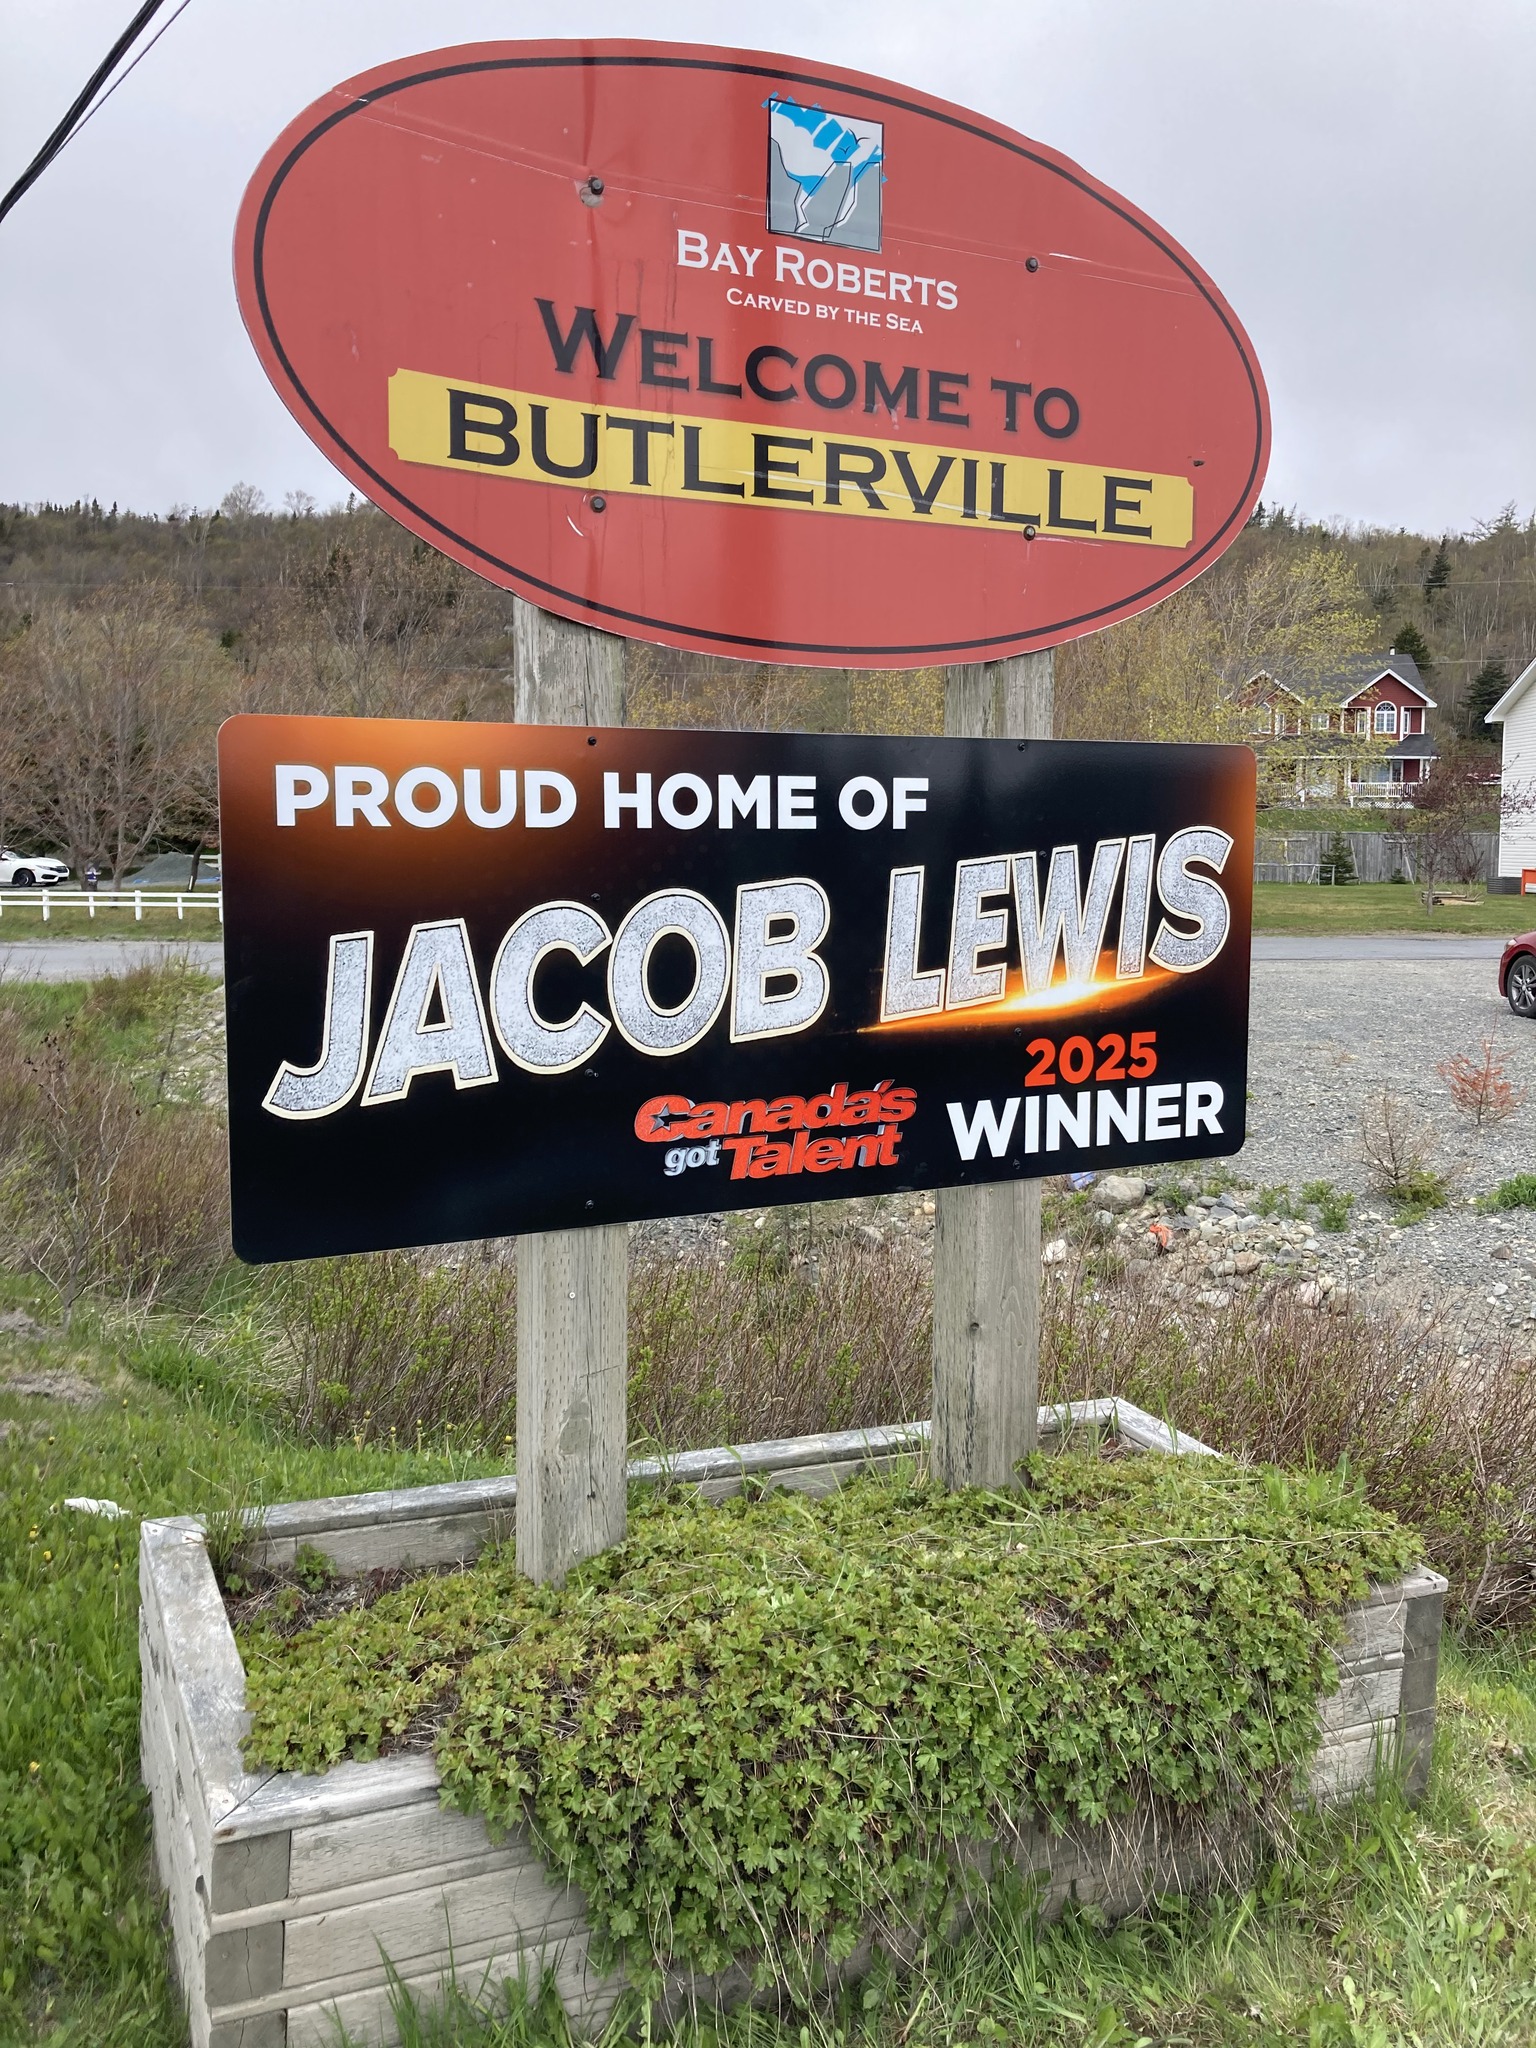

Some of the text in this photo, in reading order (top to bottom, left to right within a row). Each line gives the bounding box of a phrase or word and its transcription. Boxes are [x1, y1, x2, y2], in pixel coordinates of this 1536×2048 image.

[677, 229, 959, 310] BAY ROBERTS
[726, 288, 924, 334] CARVED BY THE SEA
[534, 298, 1082, 440] WELCOME TO
[447, 388, 1154, 541] BUTLERVILLE
[275, 764, 929, 830] PROUD HOME OF
[261, 825, 1234, 1121] JACOB LEWIS
[1025, 1031, 1158, 1087] 2025
[634, 1079, 918, 1143] Canada's
[946, 1080, 1225, 1161] WINNER
[663, 1124, 904, 1180] got Talent
